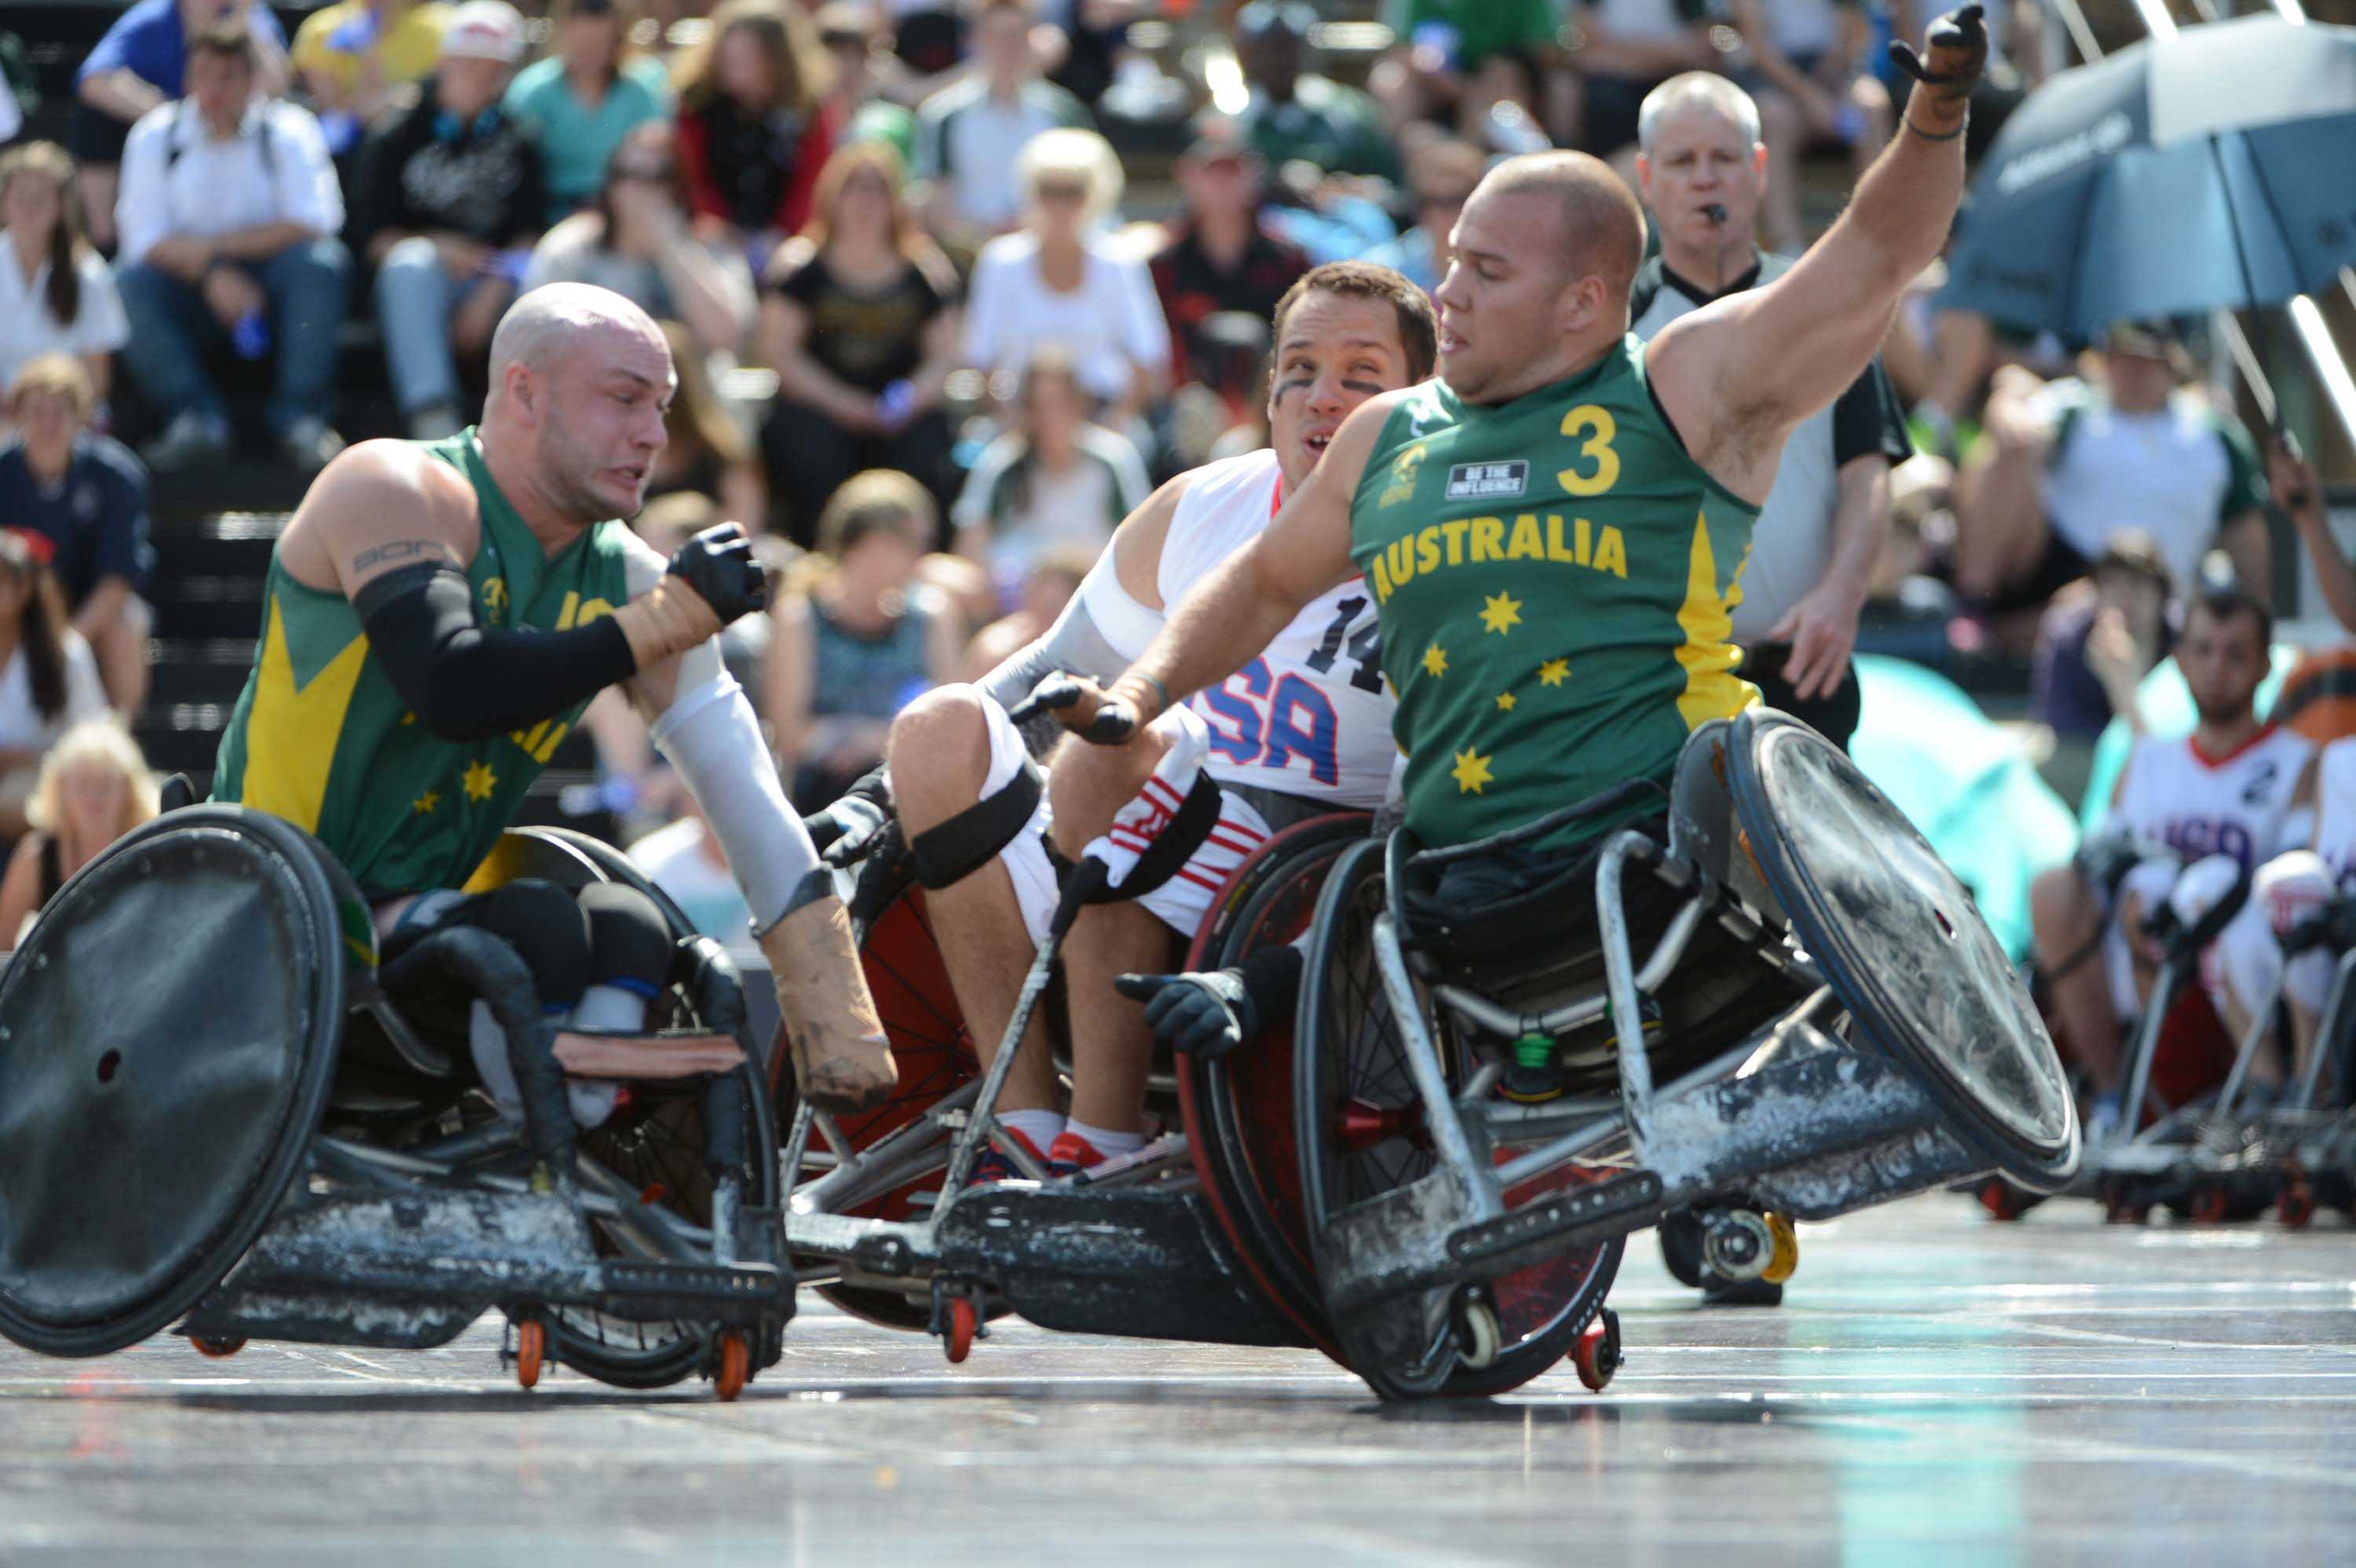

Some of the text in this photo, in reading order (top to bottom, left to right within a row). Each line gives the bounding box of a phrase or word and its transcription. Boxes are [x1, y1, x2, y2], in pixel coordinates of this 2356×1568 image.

[1557, 404, 1620, 496] 3
[1372, 514, 1628, 606] AUSTRALIA
[1305, 595, 1384, 695] 14
[1180, 653, 1338, 787] SA
